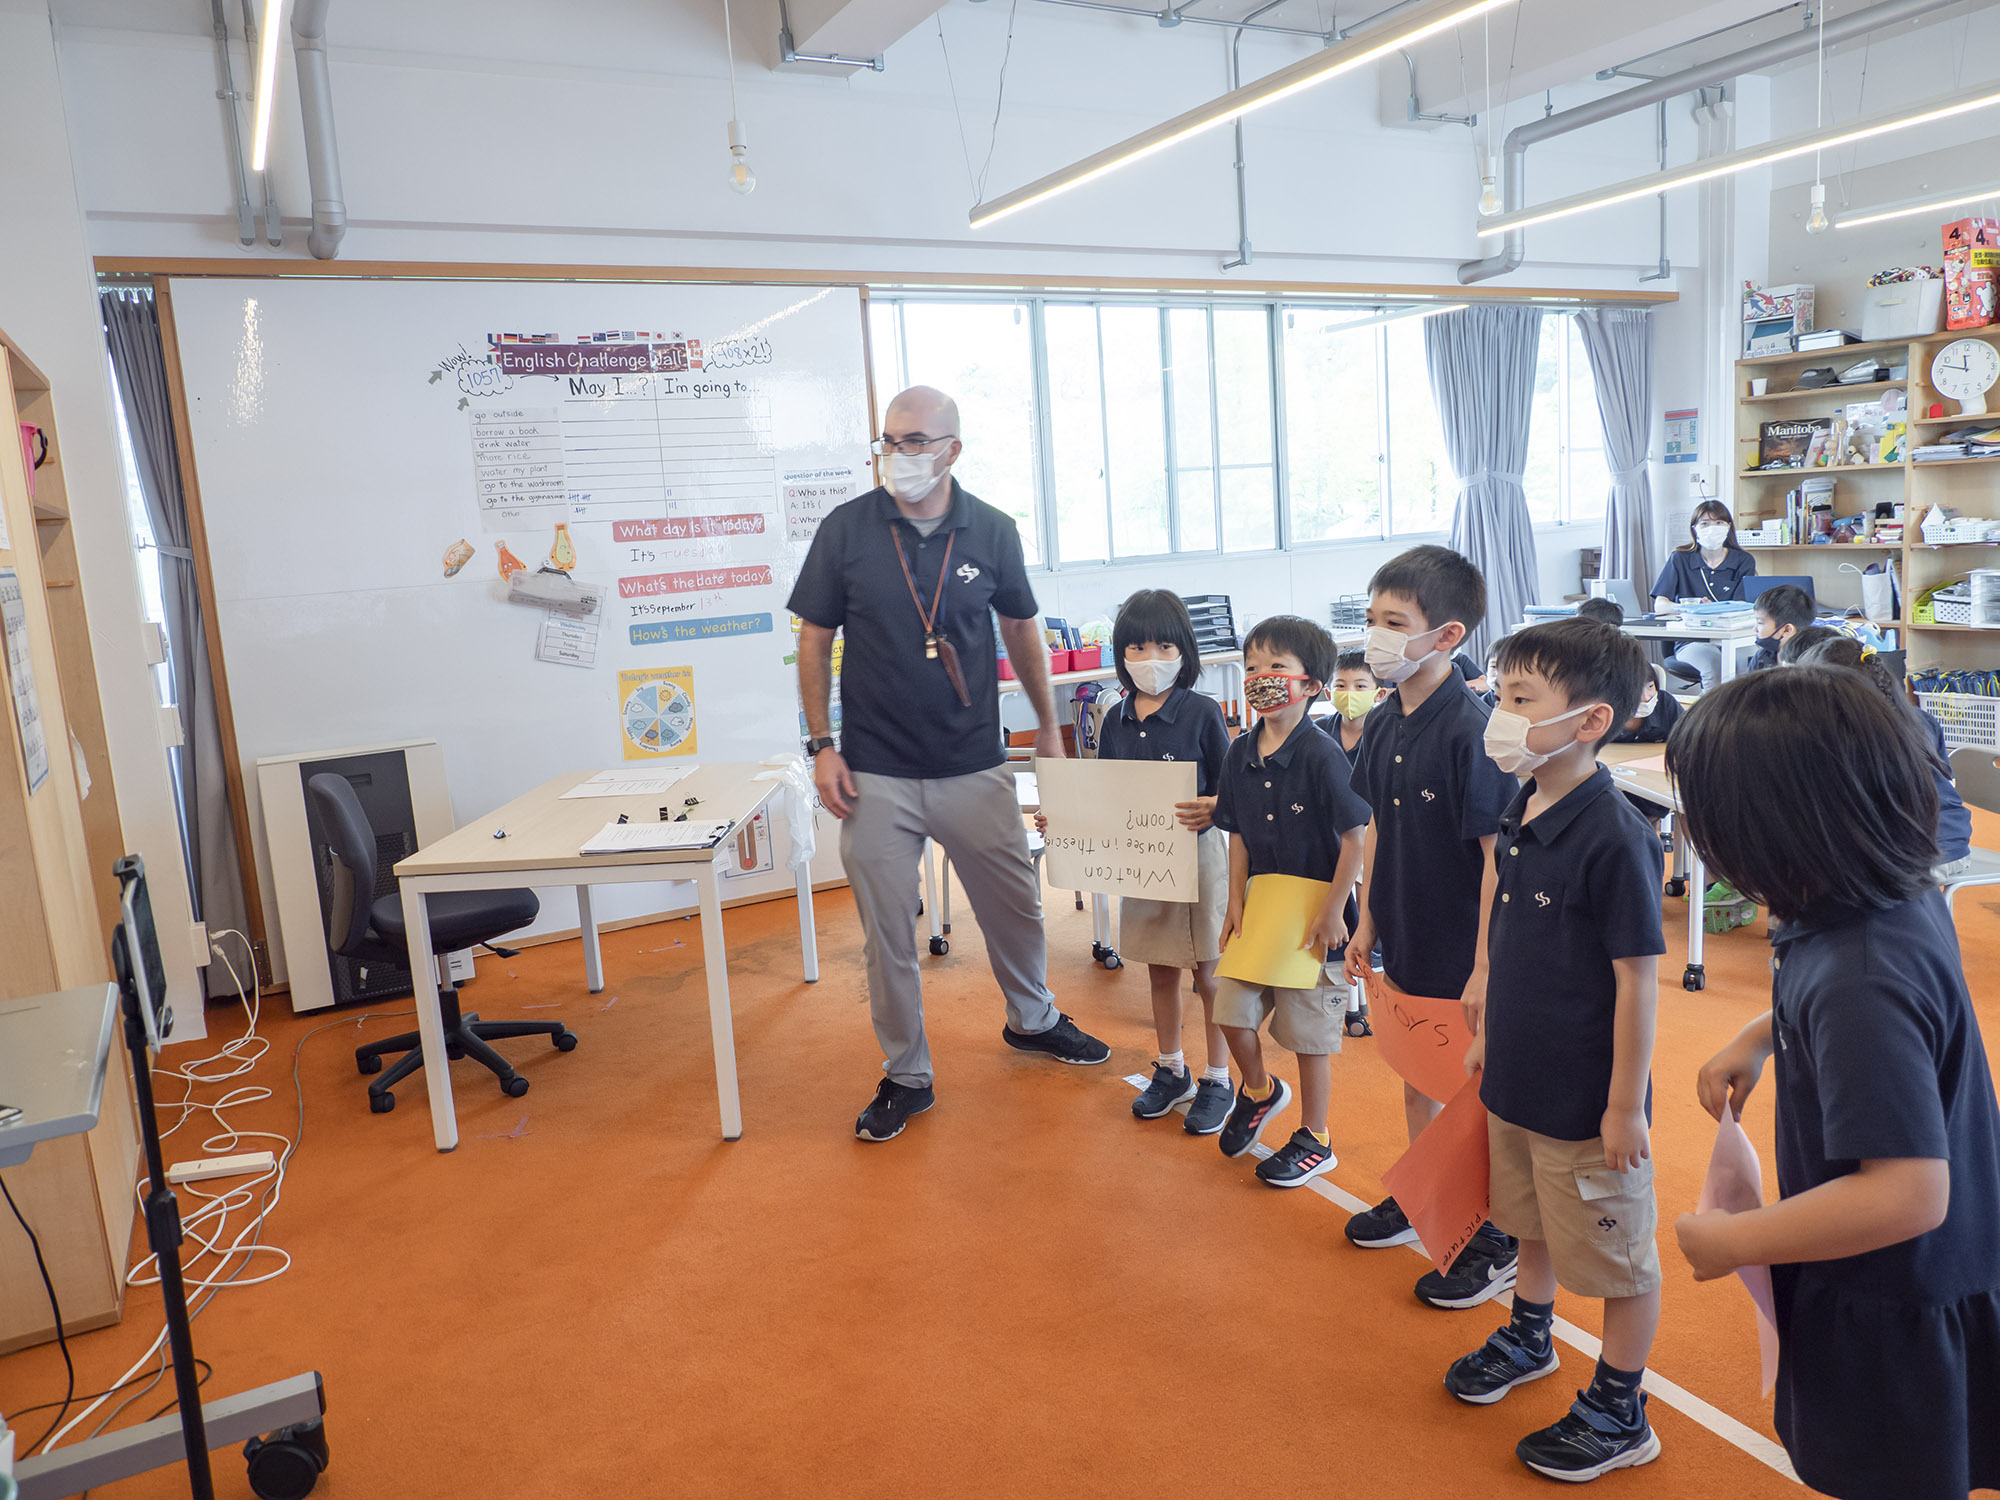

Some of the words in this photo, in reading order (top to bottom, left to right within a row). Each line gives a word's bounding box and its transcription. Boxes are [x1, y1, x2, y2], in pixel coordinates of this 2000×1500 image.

[438, 342, 472, 372] Wow!
[503, 352, 564, 372] English
[567, 352, 647, 371] Challenge
[467, 368, 501, 388] 1057
[569, 377, 606, 397] May
[664, 378, 688, 394] I'm
[693, 380, 730, 398] going
[475, 413, 486, 424] go
[493, 410, 524, 418] outside
[476, 427, 504, 436] borrow
[519, 426, 539, 435] book
[1767, 424, 1821, 436] Manitoba
[505, 440, 531, 448] water
[481, 468, 507, 477] water
[513, 467, 525, 476] my
[530, 465, 548, 475] plant
[485, 483, 496, 493] go
[510, 480, 523, 488] the
[527, 479, 564, 488] washroom
[829, 487, 848, 495] this?
[487, 498, 498, 508] go
[802, 501, 816, 509] It's
[619, 523, 658, 538] What
[663, 521, 687, 536] day
[722, 516, 764, 533] today?
[803, 529, 812, 537] In
[630, 548, 656, 562] It's
[621, 576, 667, 595] What's
[673, 575, 695, 589] the
[697, 571, 725, 587] date
[731, 569, 773, 584] today?
[631, 604, 649, 617] It's
[650, 602, 695, 616] September
[632, 626, 669, 642] How's
[674, 624, 697, 637] the
[701, 618, 761, 634] weather?
[1126, 810, 1175, 831] room?
[1101, 837, 1119, 851] in
[1116, 867, 1176, 889] What
